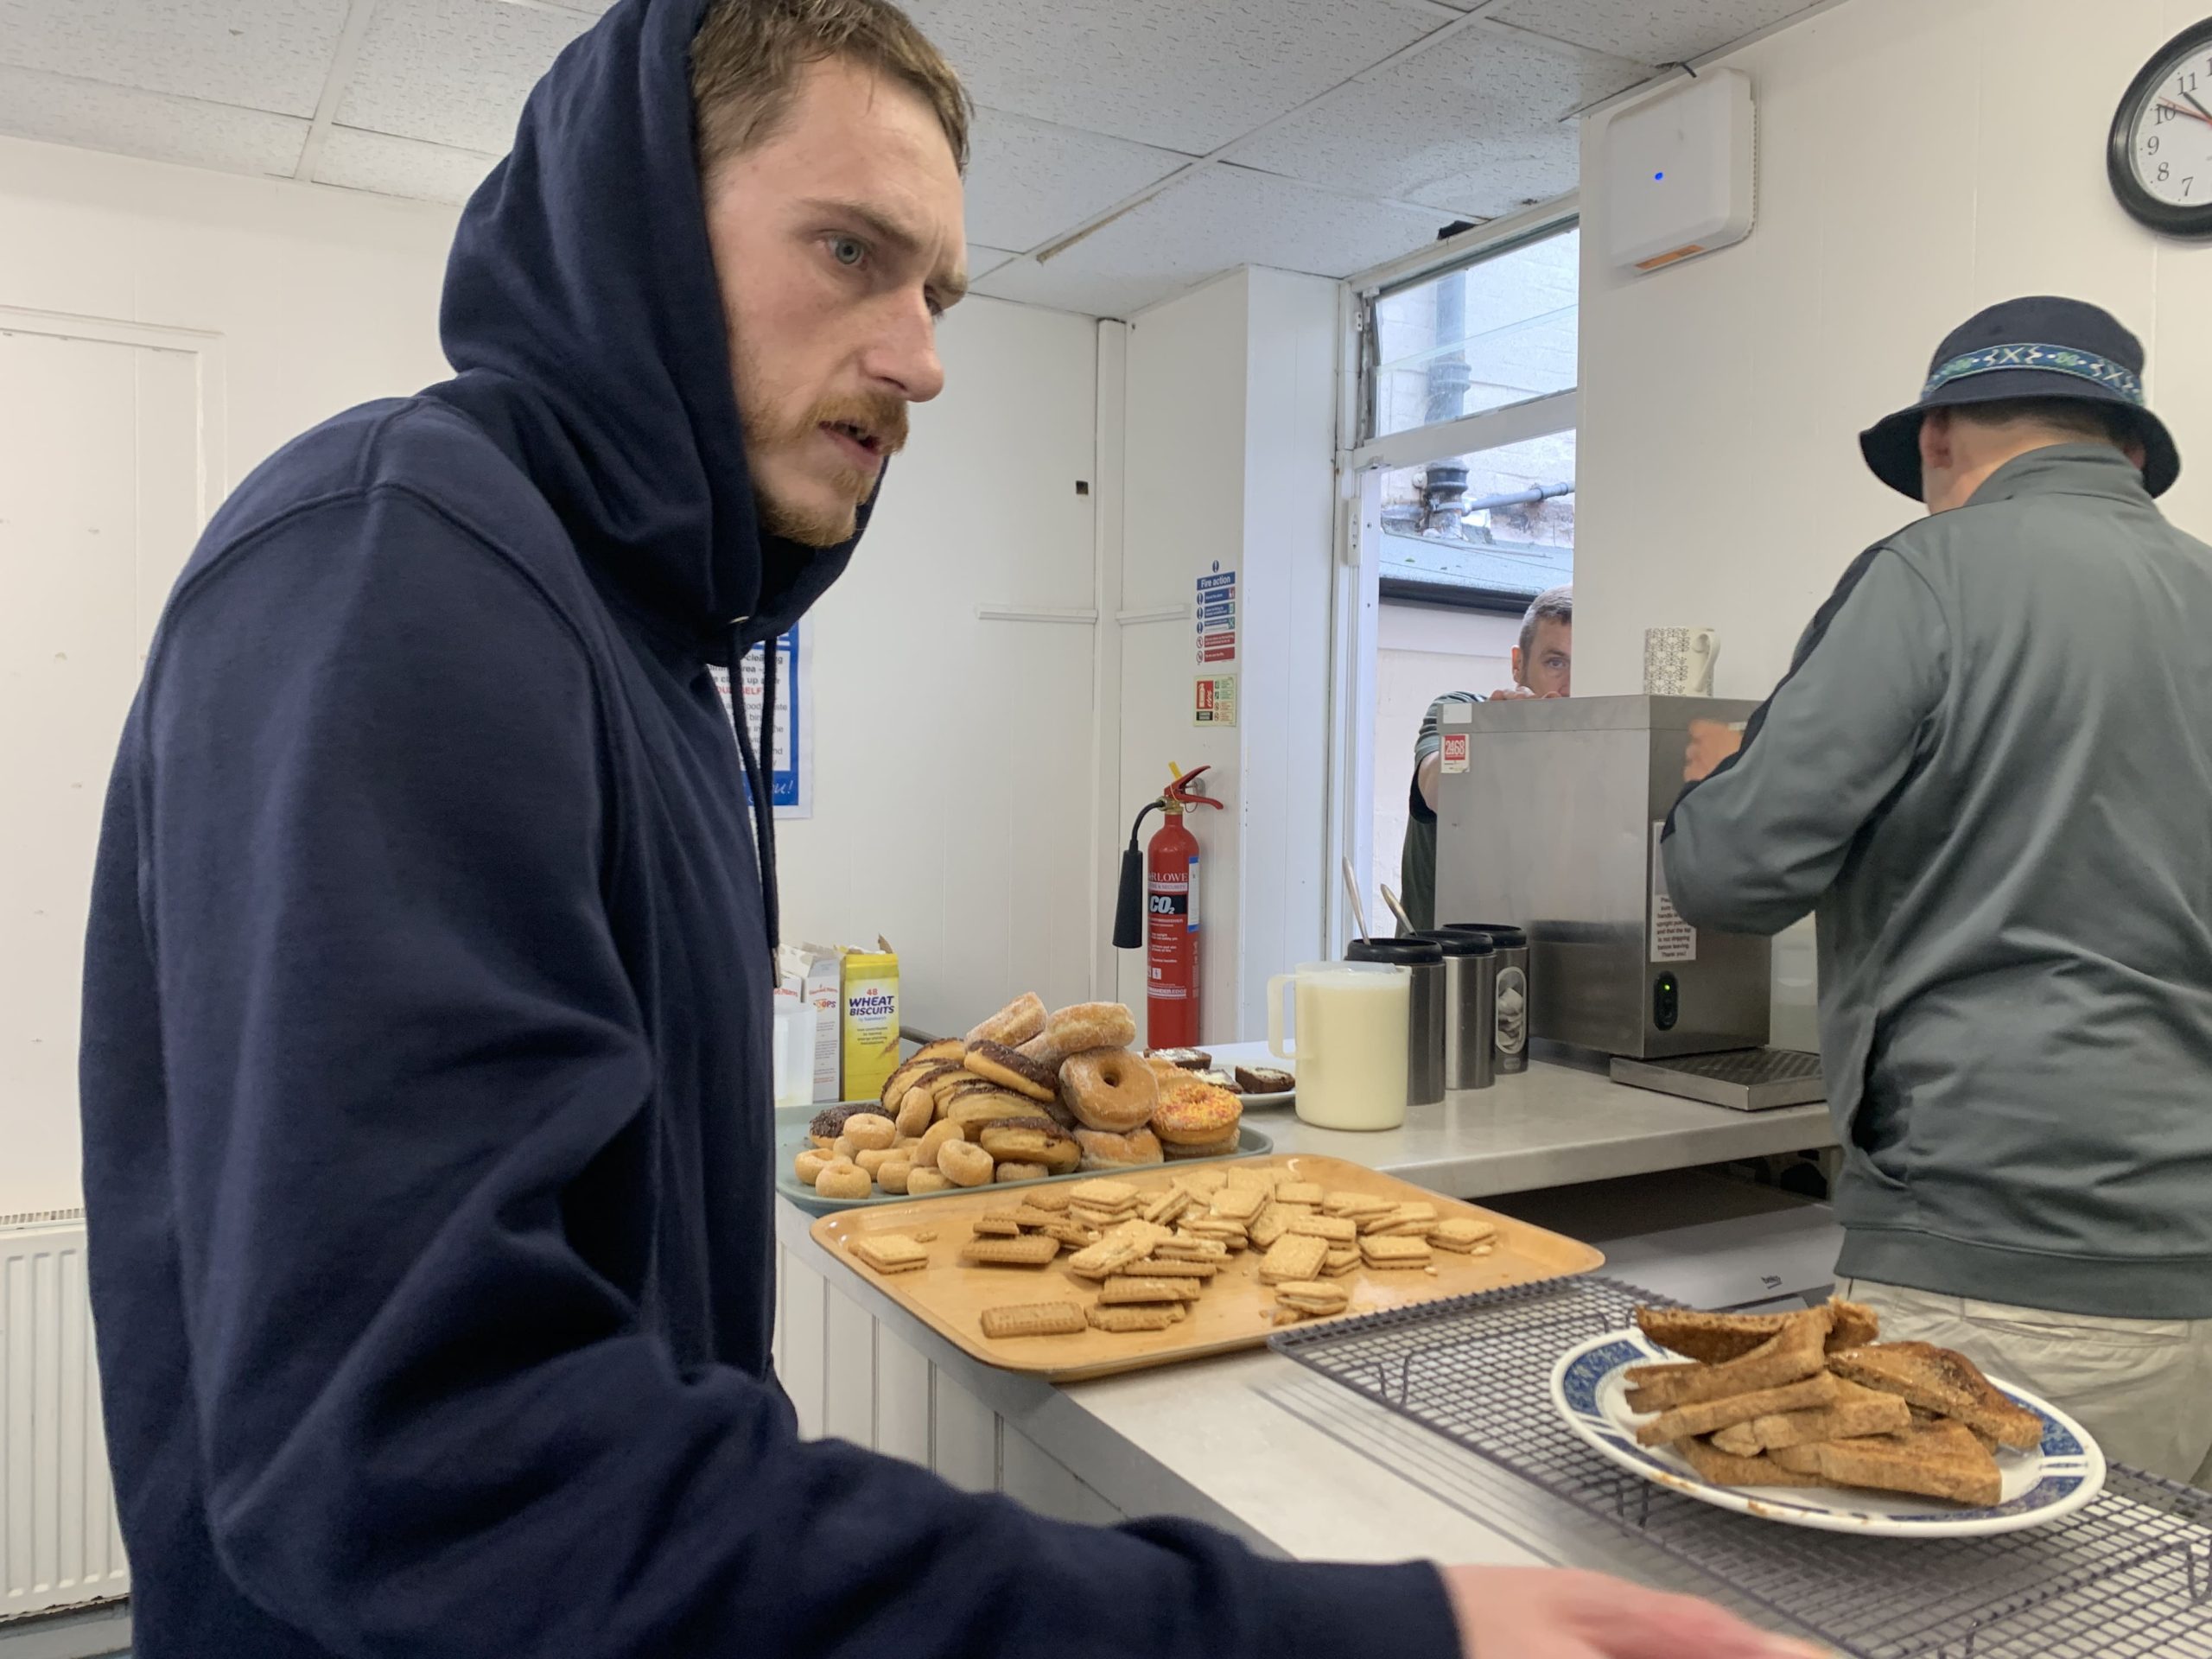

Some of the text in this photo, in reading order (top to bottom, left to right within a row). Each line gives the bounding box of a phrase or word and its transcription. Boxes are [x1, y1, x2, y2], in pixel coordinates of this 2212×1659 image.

[2177, 72, 2198, 95] 11
[2154, 100, 2176, 125] 10
[2147, 136, 2159, 156] 9
[2157, 162, 2170, 181] 8
[2182, 176, 2194, 197] 7
[1200, 575, 1230, 588] Fire action
[849, 995, 894, 1007] WHEAT
[866, 988, 878, 996] 48
[849, 1006, 895, 1016] BISCUITS
